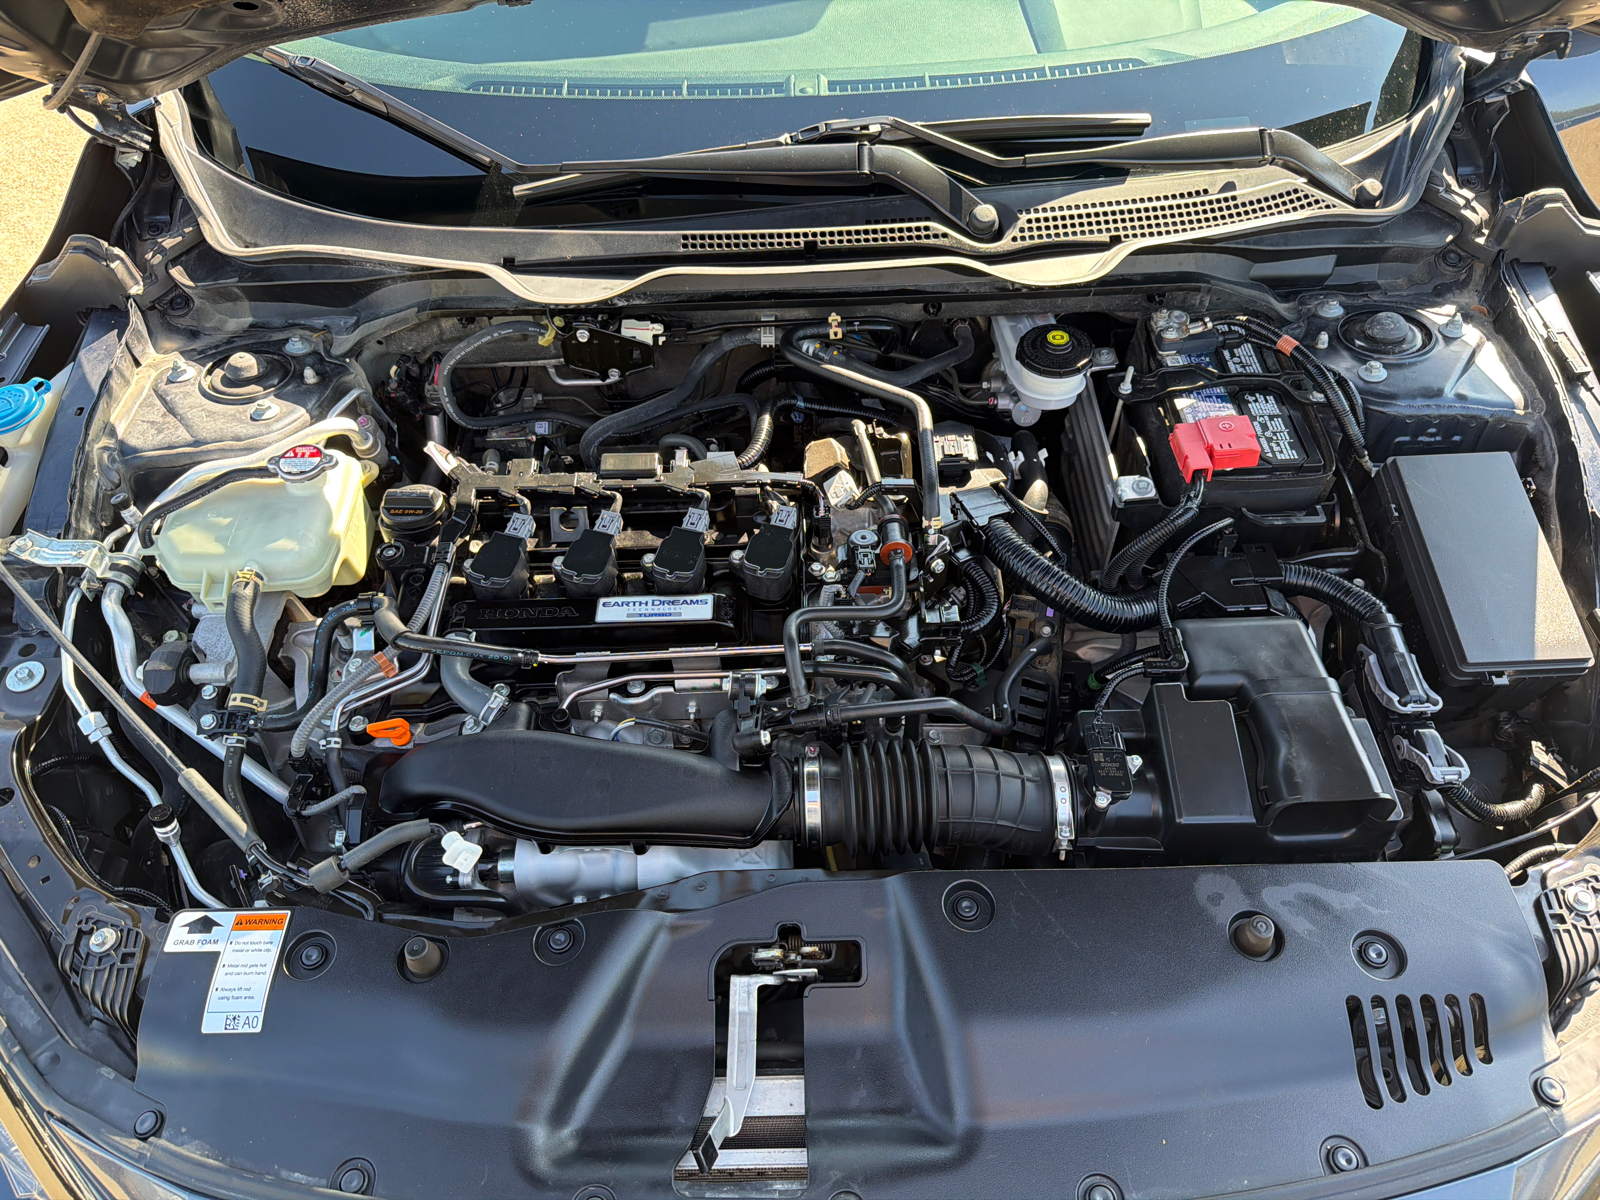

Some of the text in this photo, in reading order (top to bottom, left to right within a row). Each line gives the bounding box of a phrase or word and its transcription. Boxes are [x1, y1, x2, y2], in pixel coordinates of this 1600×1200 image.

[601, 599, 709, 608] EARTH DREAMS
[478, 606, 580, 620] HONDA
[245, 918, 284, 926] WARNING
[241, 1015, 259, 1029] A0
